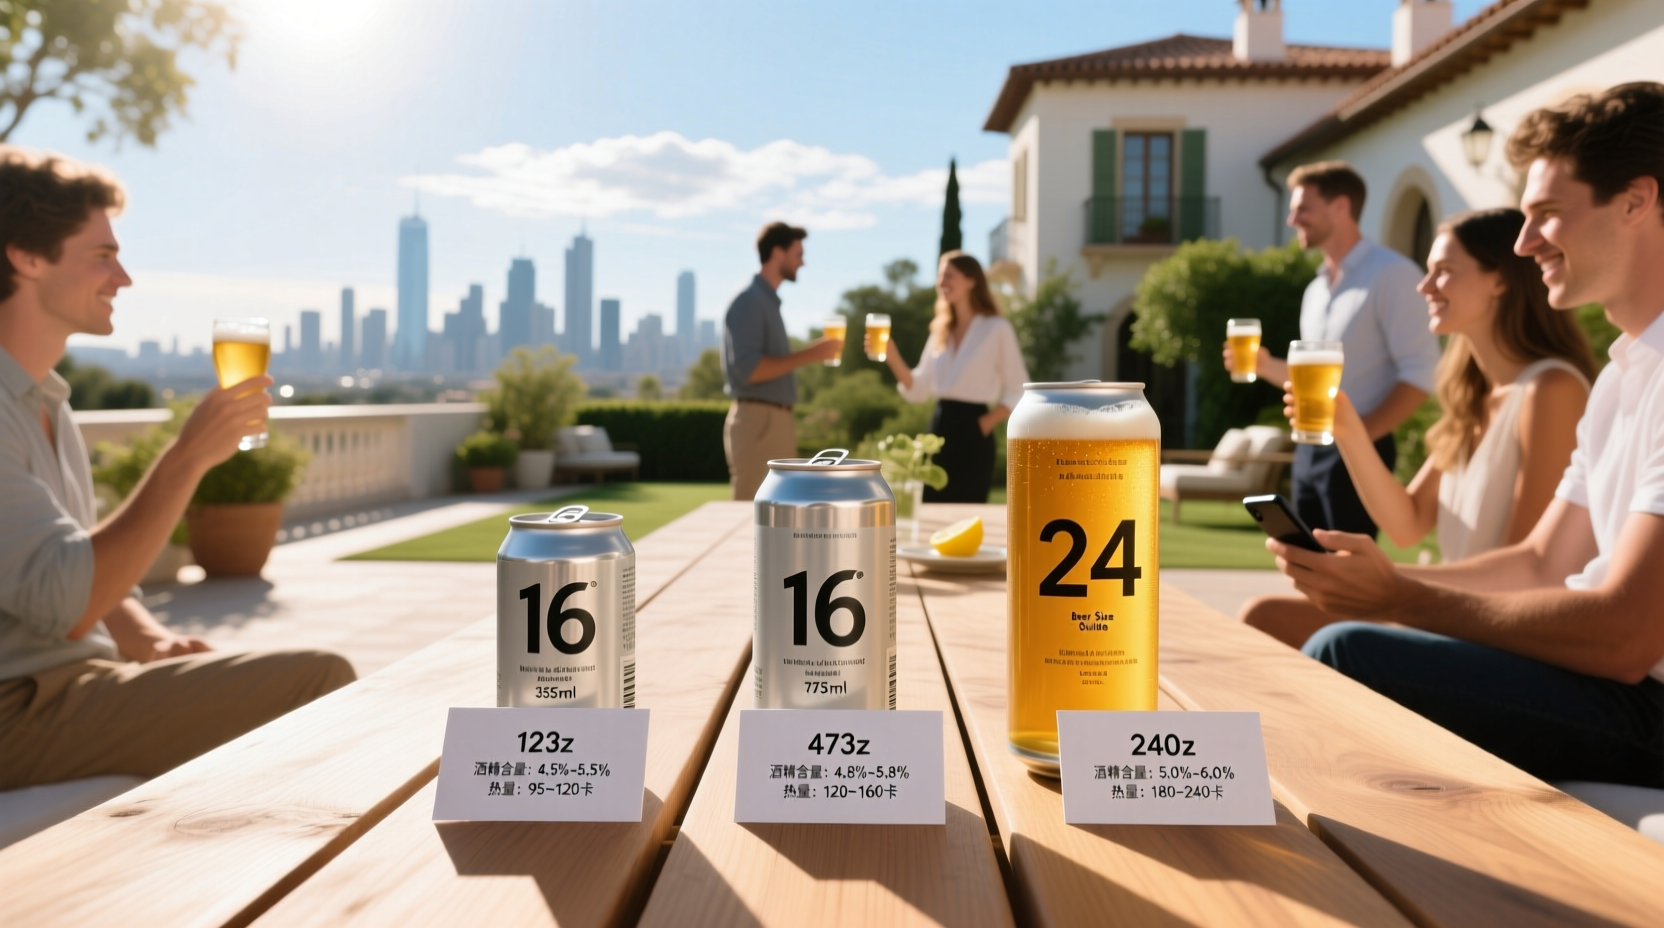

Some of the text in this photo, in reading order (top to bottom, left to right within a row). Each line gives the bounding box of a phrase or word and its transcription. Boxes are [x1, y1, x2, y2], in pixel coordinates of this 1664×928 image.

[1038, 518, 1142, 598] 24
[535, 685, 576, 699] 355ml
[804, 680, 847, 694] 775ml
[517, 731, 574, 753] 123z
[807, 732, 871, 755] 473z
